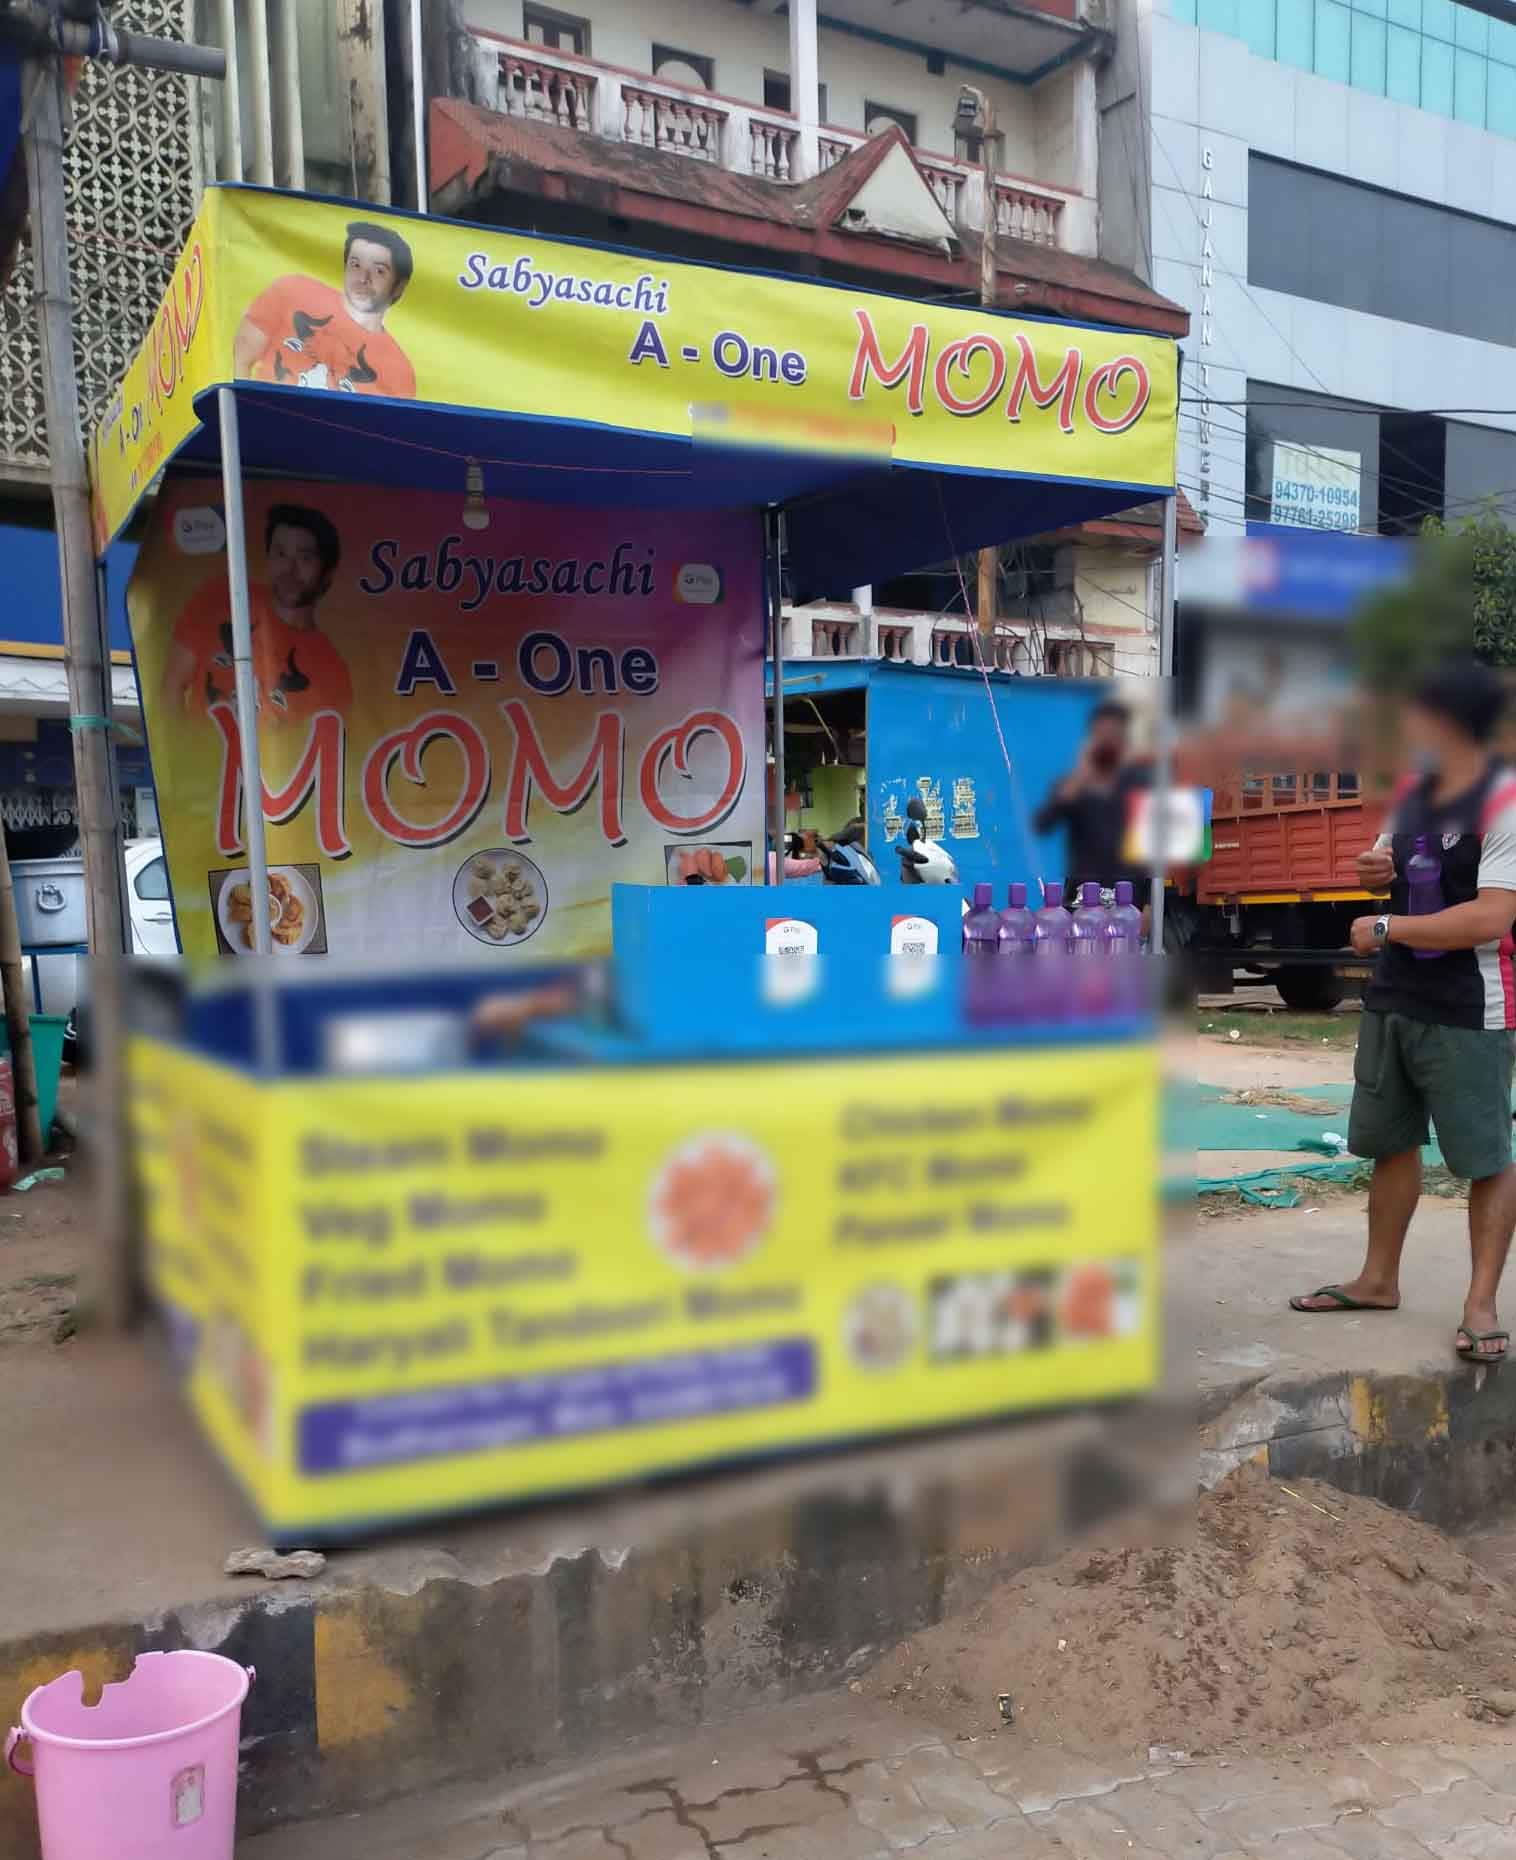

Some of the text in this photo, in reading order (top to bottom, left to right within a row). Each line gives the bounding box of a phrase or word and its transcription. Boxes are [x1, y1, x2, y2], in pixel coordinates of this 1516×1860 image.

[1201, 146, 1214, 346] GAJANAN
[459, 253, 670, 314] Sabyasachi
[629, 320, 669, 369] A
[712, 332, 807, 387] One
[847, 309, 1151, 434] MOMO
[1274, 480, 1358, 508] 94370-10954
[360, 536, 656, 611] Sabyasachi
[396, 629, 456, 696] A
[518, 632, 661, 698] One
[208, 701, 747, 860] MOMO
